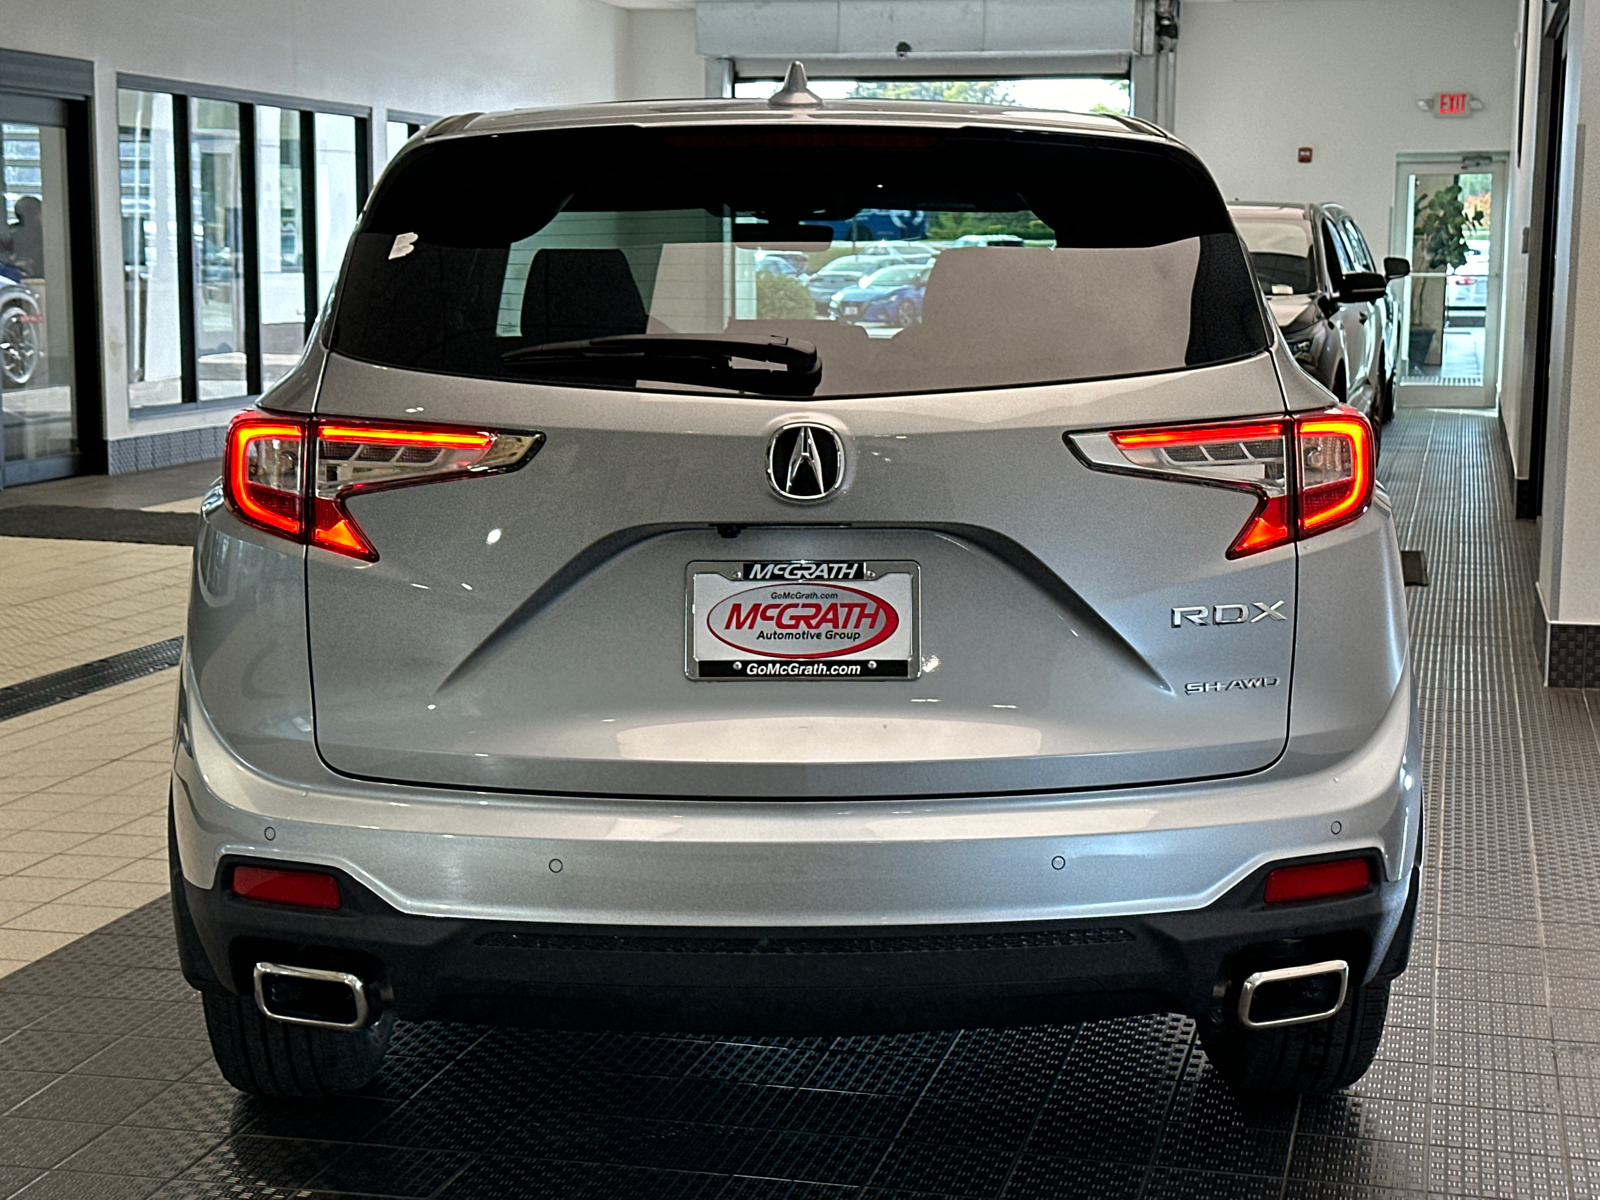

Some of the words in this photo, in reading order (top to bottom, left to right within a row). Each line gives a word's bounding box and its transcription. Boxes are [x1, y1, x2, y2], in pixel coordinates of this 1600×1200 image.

[1439, 93, 1467, 114] EXIT
[770, 591, 838, 600] GoMcGrath.com
[1171, 600, 1287, 628] RDX
[756, 630, 822, 640] Automotive
[825, 630, 861, 642] Group
[746, 663, 861, 675] GoMcGrath.com
[1184, 677, 1280, 695] SH-AWD
